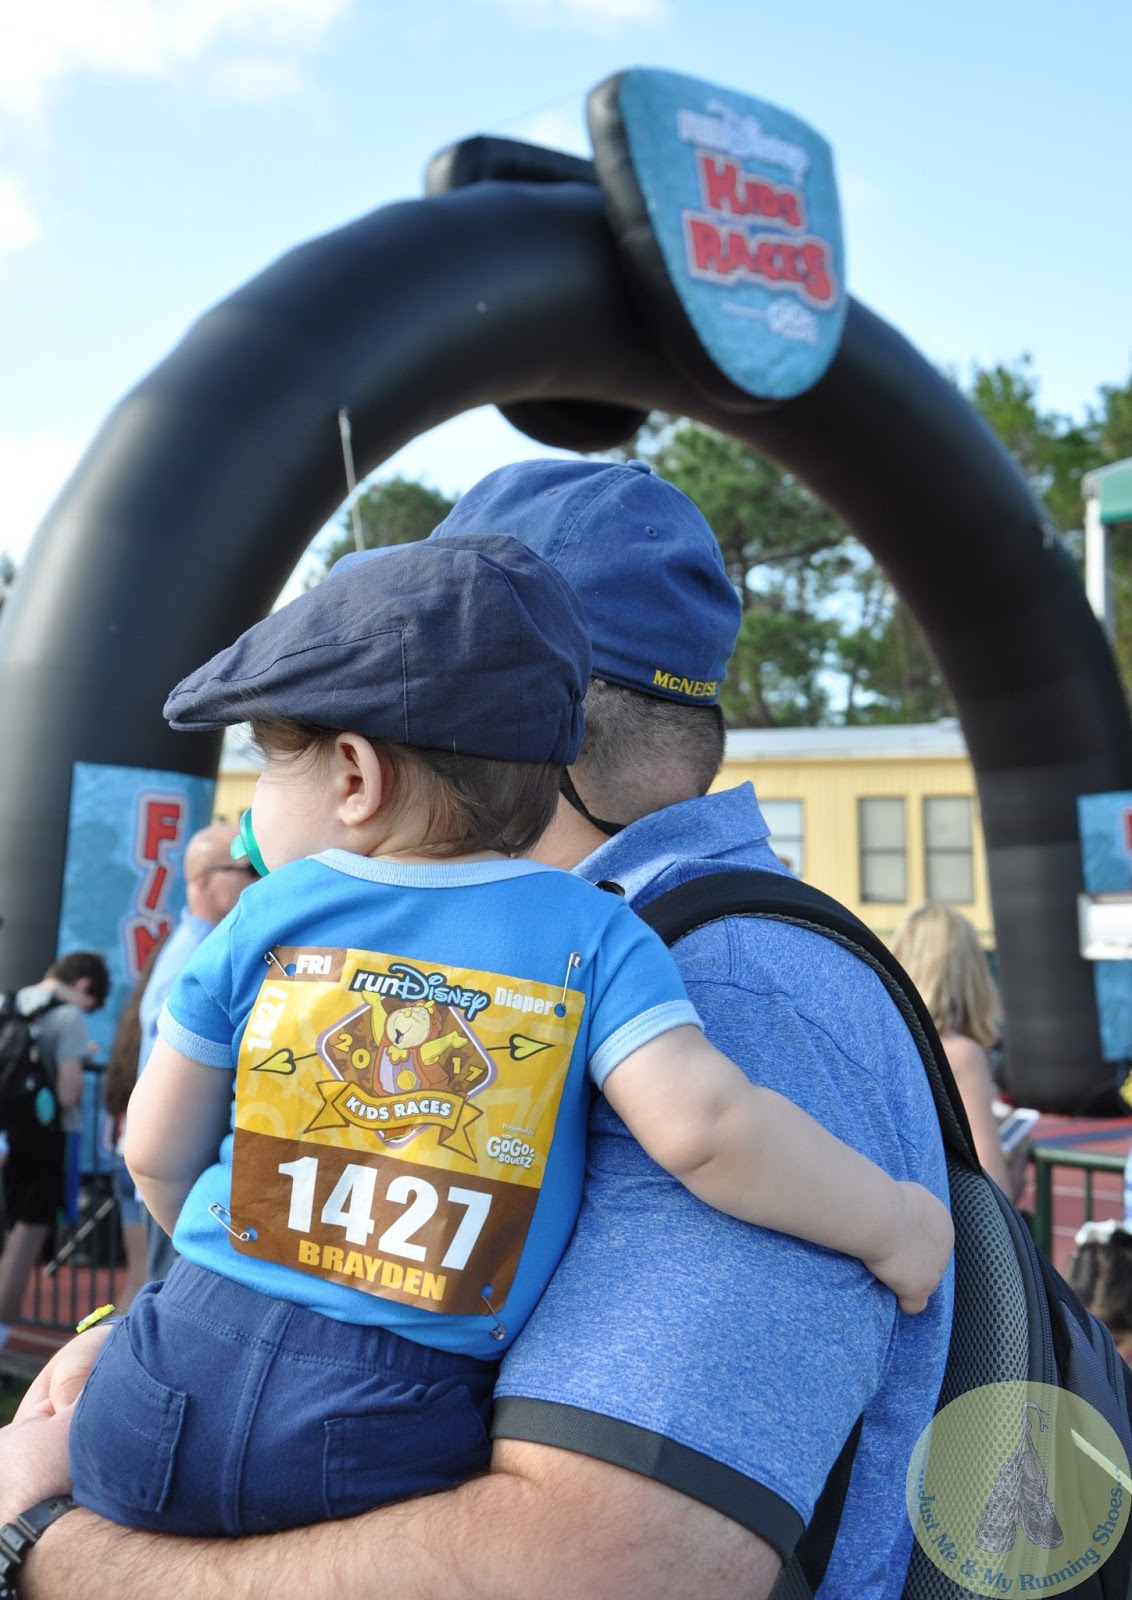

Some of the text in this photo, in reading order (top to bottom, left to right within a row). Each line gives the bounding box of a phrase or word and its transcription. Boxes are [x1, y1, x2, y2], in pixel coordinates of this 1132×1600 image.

[700, 154, 804, 229] KIDS
[687, 216, 836, 304] RACES
[294, 954, 333, 976] FRI
[246, 986, 289, 1053] 1427
[494, 986, 553, 1016] Diaper
[344, 1095, 453, 1120] KIDS RACES
[278, 1156, 493, 1271] 1427
[298, 1239, 447, 1301] BRAYDEN
